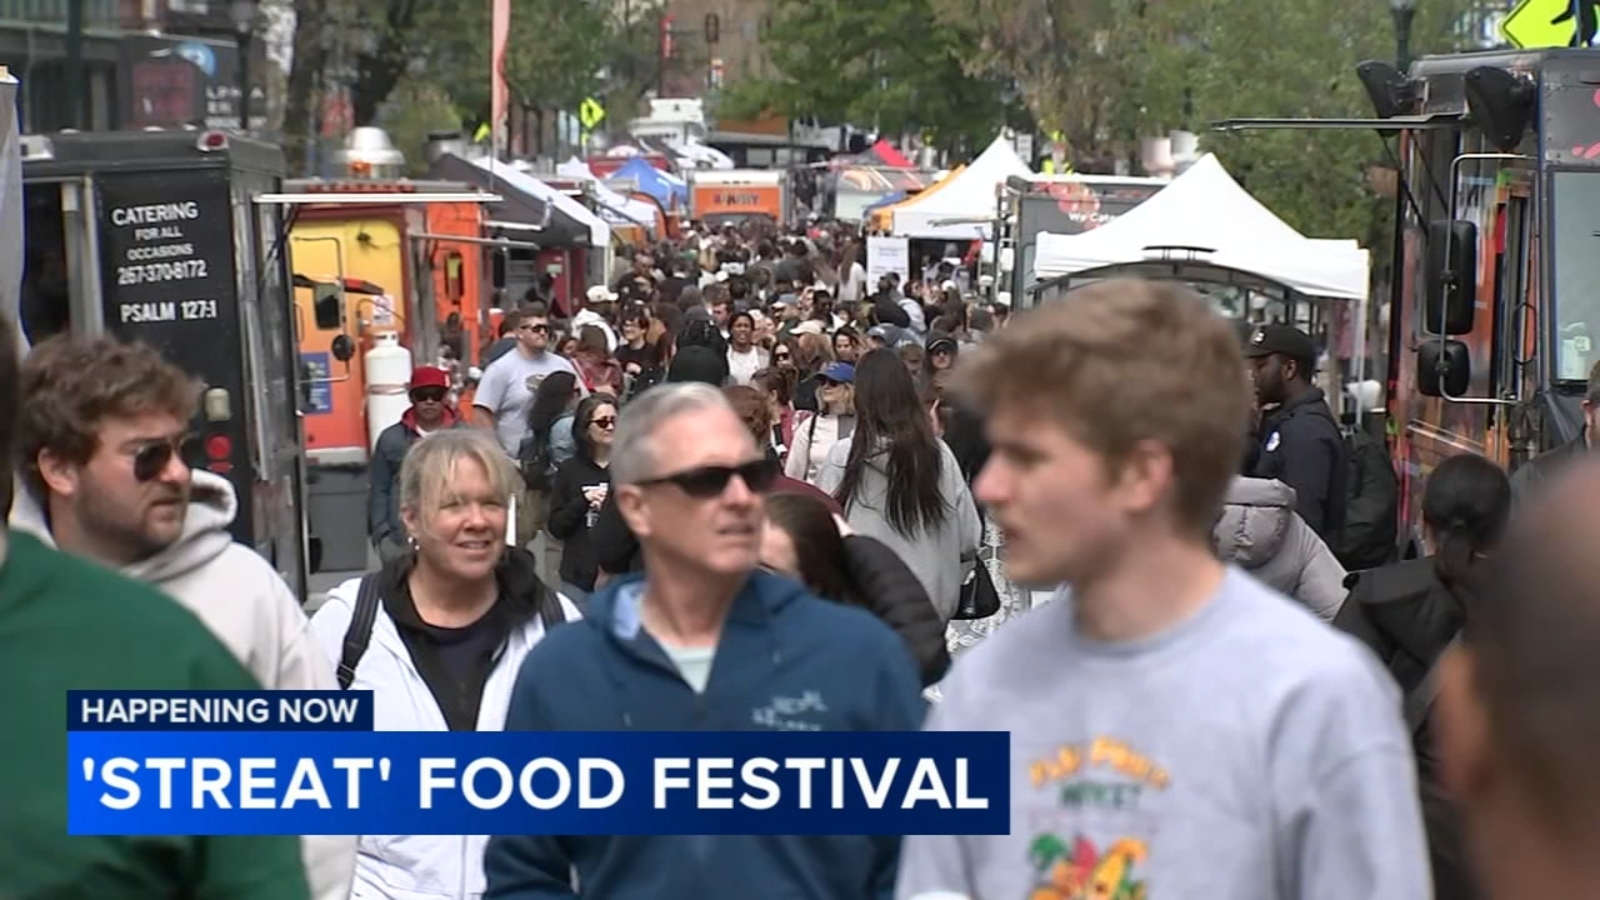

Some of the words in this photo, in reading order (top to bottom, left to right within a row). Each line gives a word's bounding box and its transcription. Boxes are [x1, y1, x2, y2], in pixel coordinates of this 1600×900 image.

[111, 201, 199, 226] CATERING
[134, 228, 160, 241] FOR
[160, 225, 183, 238] ALL
[126, 243, 194, 260] OCCASIONS
[120, 301, 176, 323] PSALM
